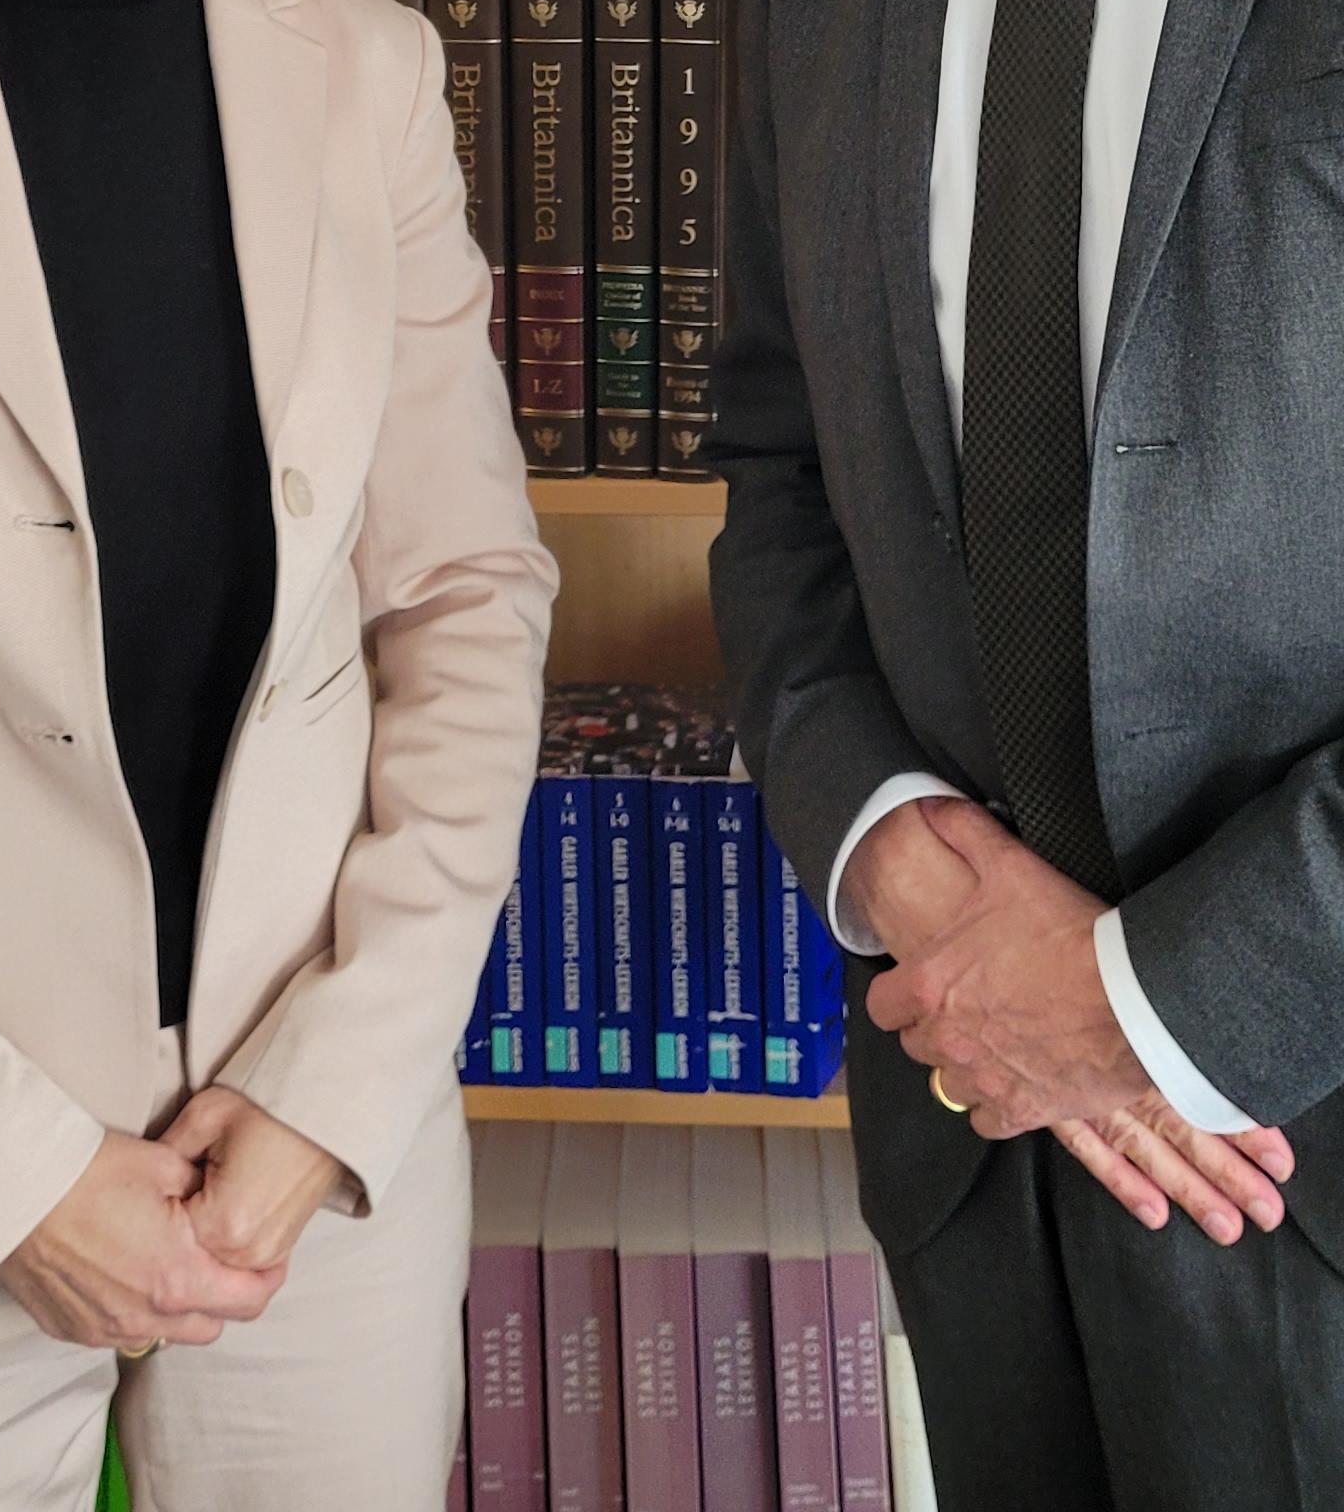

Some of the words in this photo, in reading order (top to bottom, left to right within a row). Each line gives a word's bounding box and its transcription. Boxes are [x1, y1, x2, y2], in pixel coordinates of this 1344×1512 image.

[532, 61, 562, 243] Britannica
[610, 62, 641, 243] Britannica
[482, 1327, 503, 1409] STAATS
[505, 1311, 525, 1409] LEXIKON
